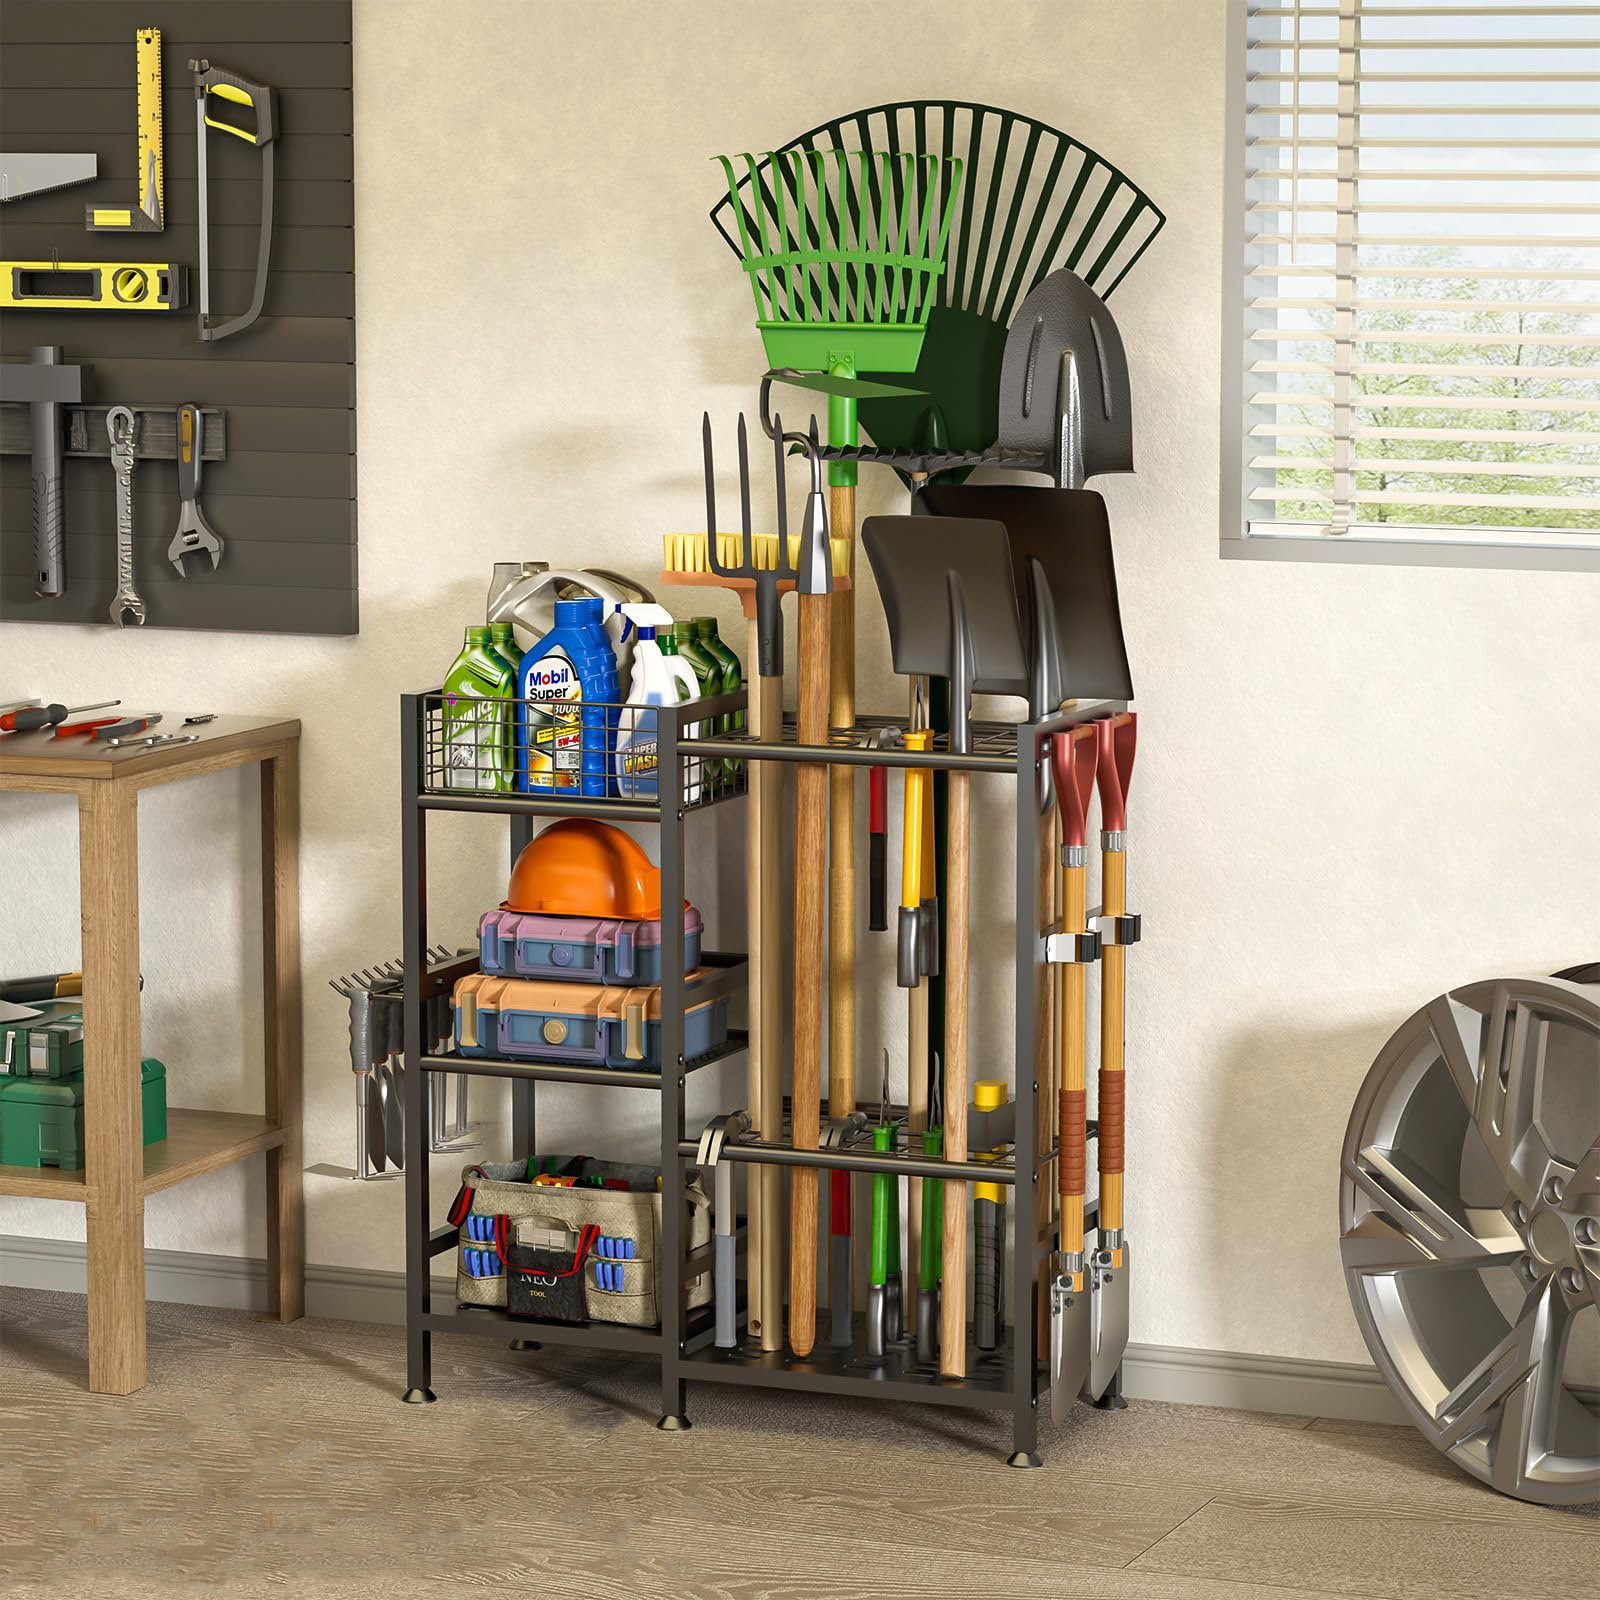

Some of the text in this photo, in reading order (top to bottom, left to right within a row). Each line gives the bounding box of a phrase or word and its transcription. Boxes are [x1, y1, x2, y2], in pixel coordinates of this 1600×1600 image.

[529, 668, 569, 687] Mobil
[529, 687, 569, 701] Super
[554, 704, 579, 714] 3000
[529, 1290, 546, 1298] TOOL
